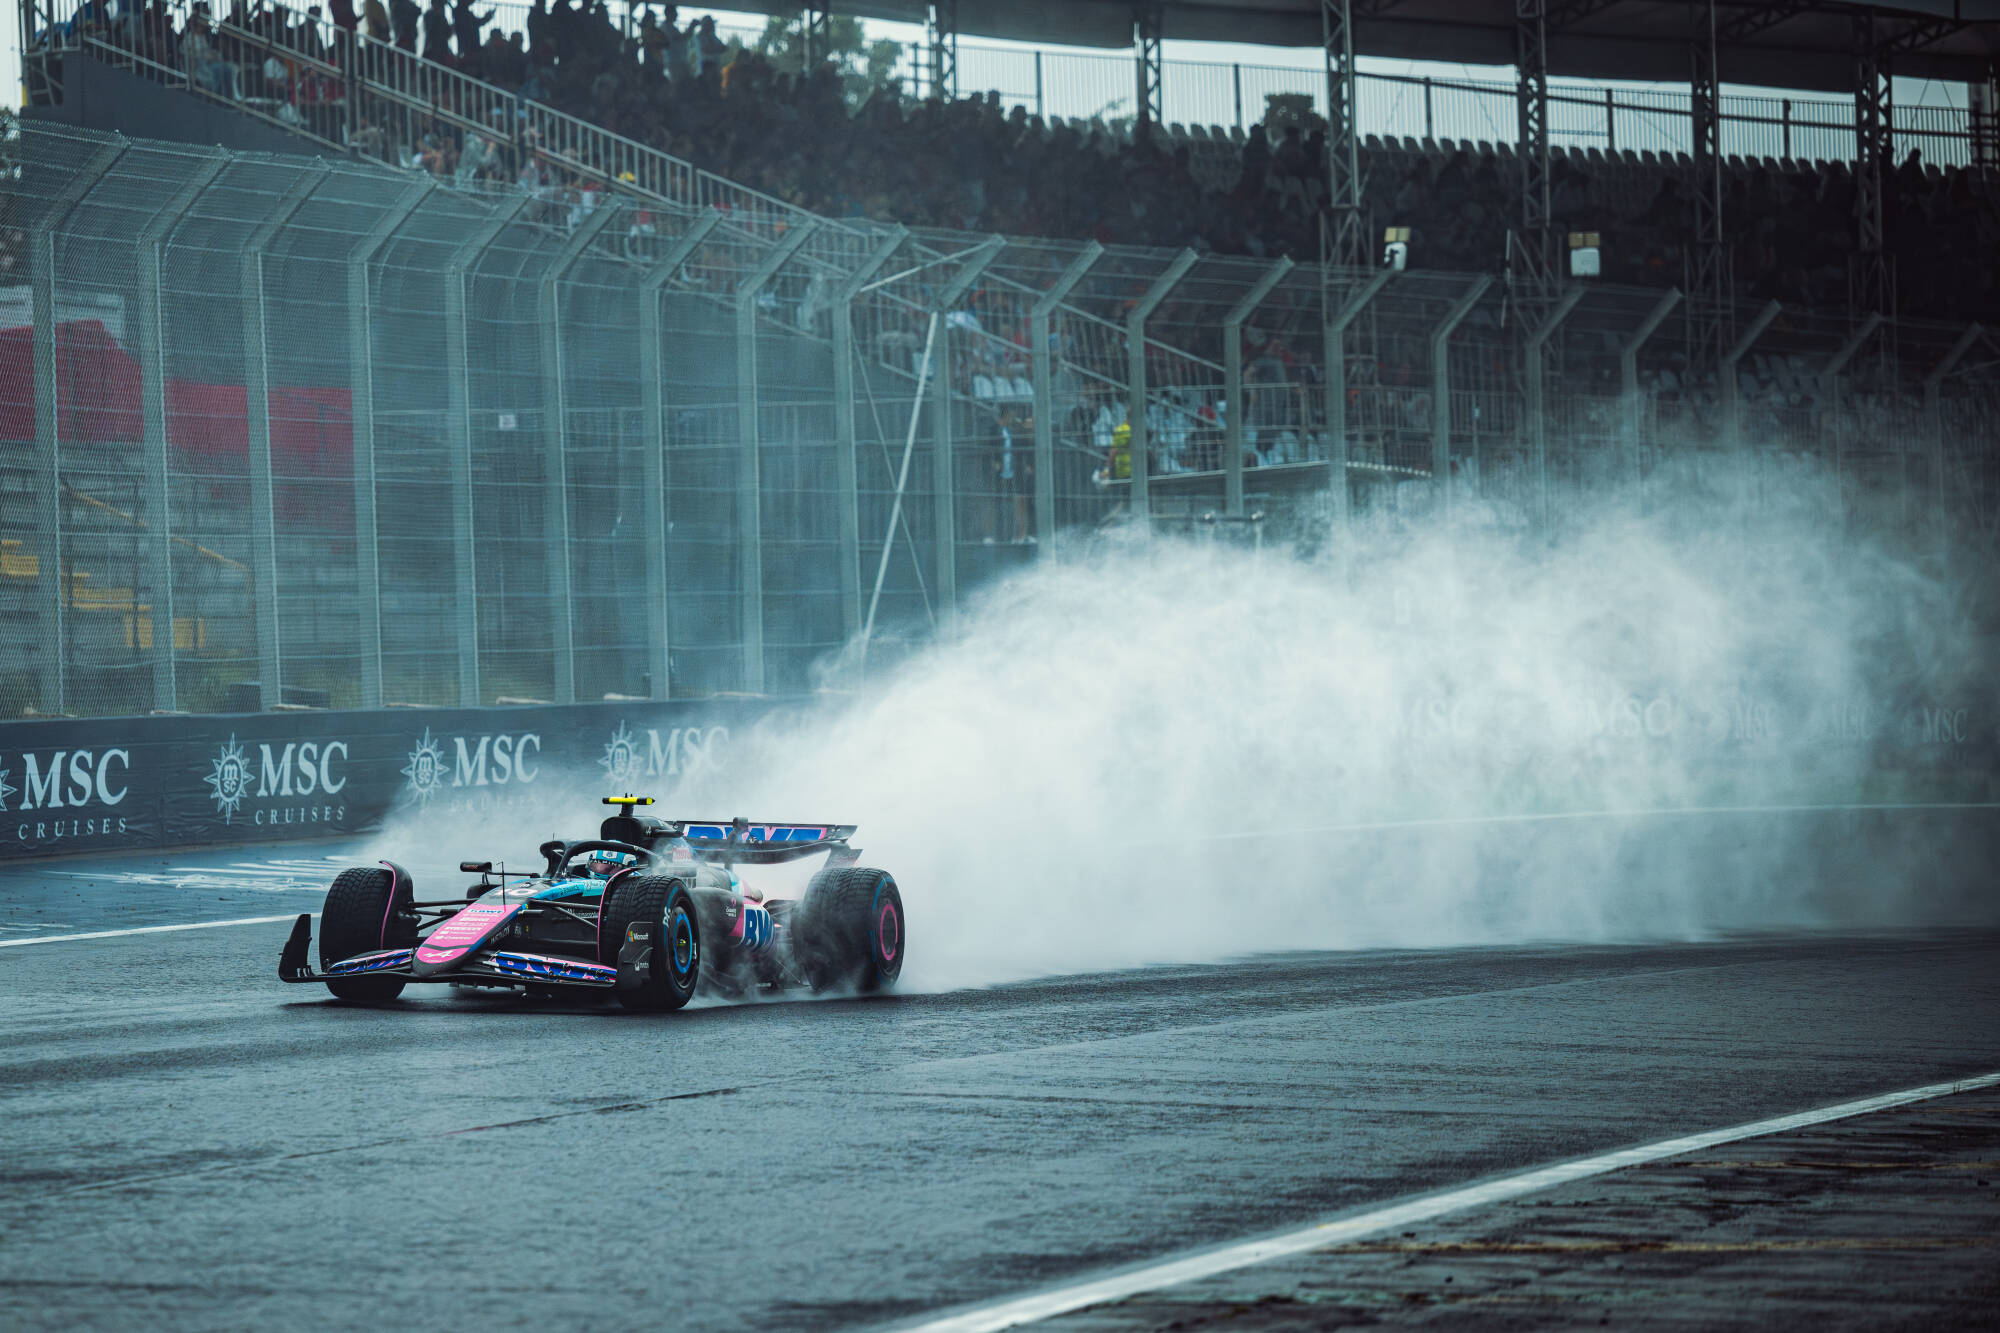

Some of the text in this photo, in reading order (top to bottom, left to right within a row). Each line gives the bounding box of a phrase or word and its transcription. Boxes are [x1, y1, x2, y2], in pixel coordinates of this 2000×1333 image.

[1922, 707, 1968, 744] MSC
[257, 741, 348, 797] MSC
[452, 734, 541, 787] MSC
[646, 726, 729, 776] MSC
[19, 749, 129, 810] MSC
[18, 817, 128, 841] CRUISES
[255, 805, 345, 826] CRUISES
